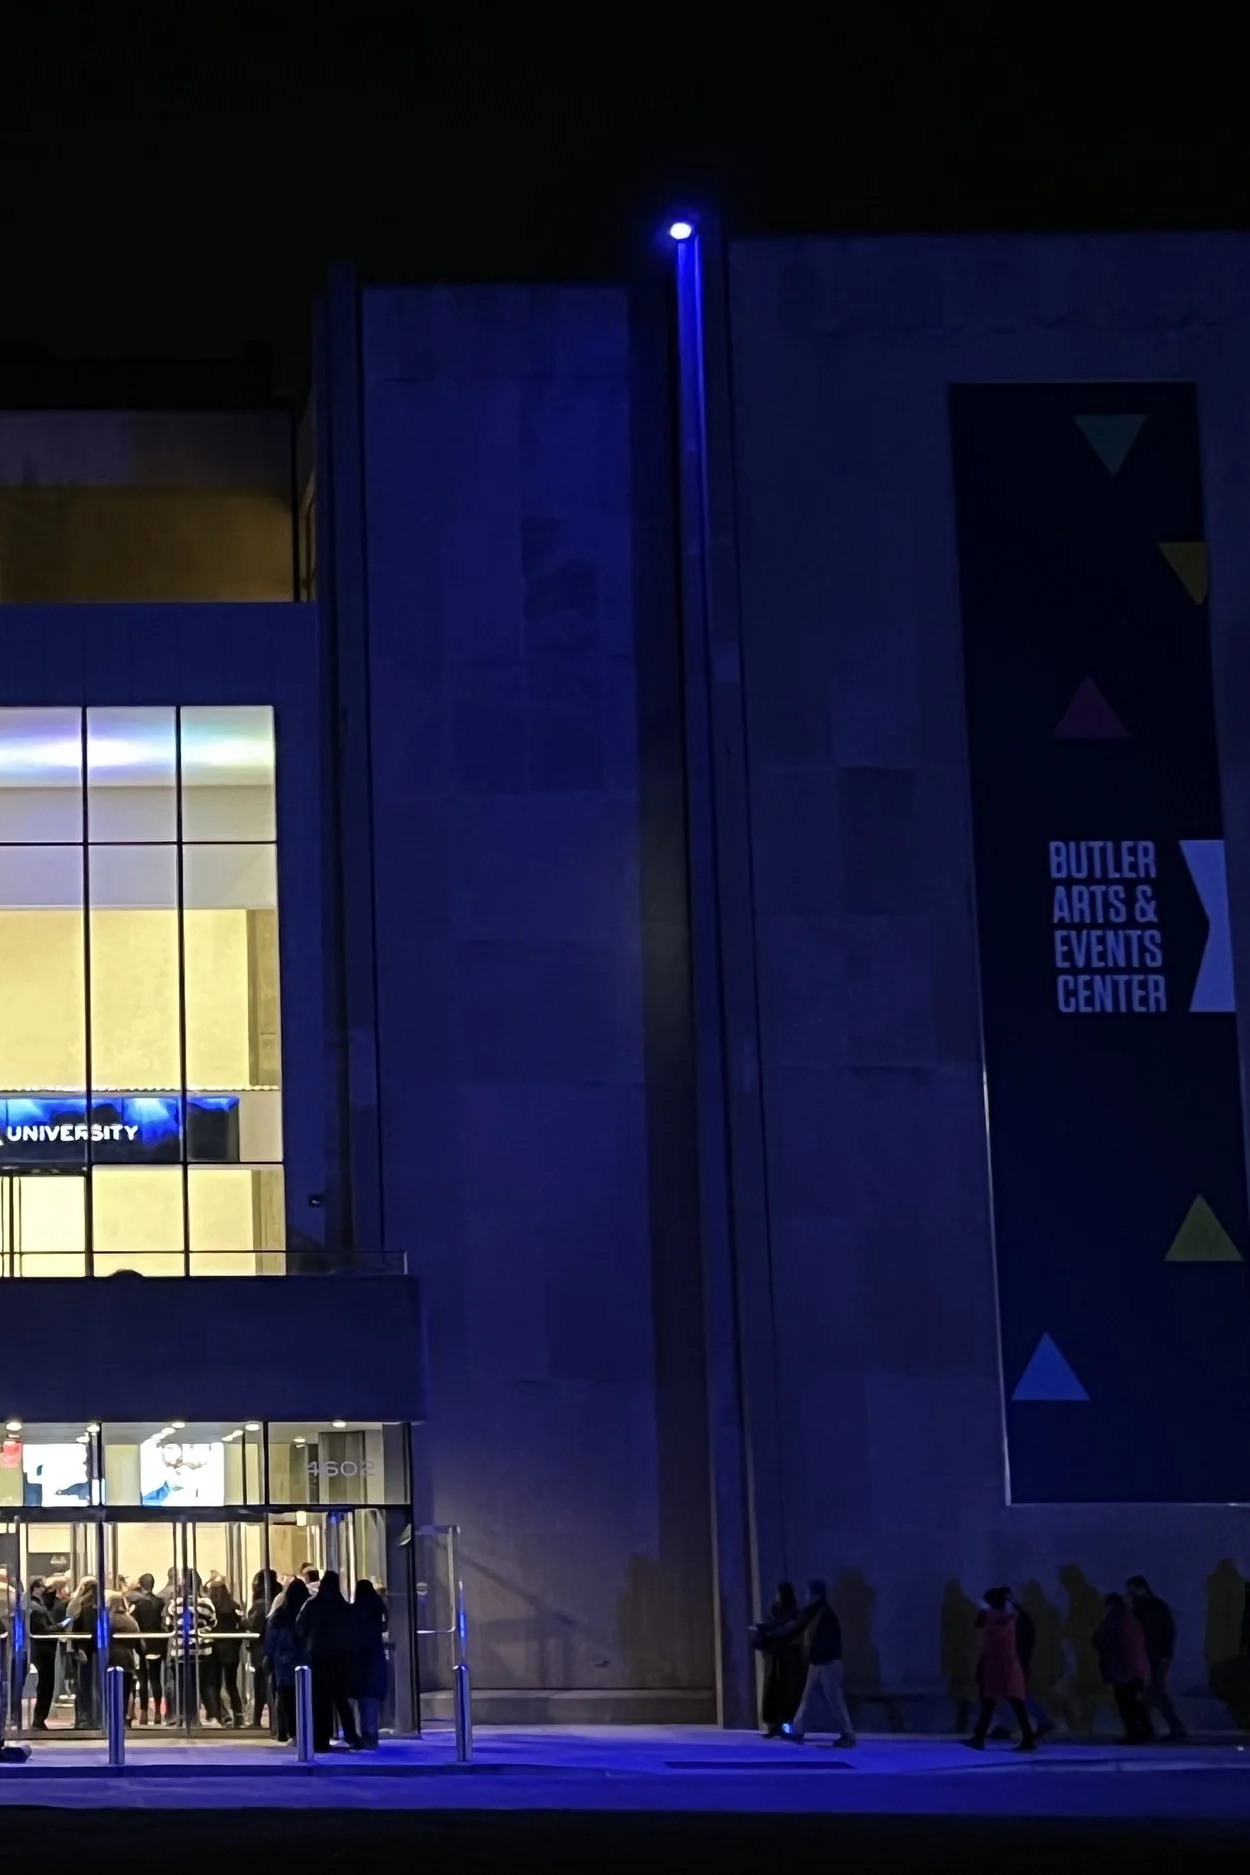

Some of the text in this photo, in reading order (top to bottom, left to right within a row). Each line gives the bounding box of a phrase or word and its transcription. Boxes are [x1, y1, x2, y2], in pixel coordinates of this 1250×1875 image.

[1049, 840, 1158, 879] BUTLER
[1052, 884, 1159, 924] ARTS &
[1054, 929, 1163, 969] EVENTS
[1056, 974, 1168, 1014] CENTER
[7, 1123, 139, 1142] UNIVERSITY
